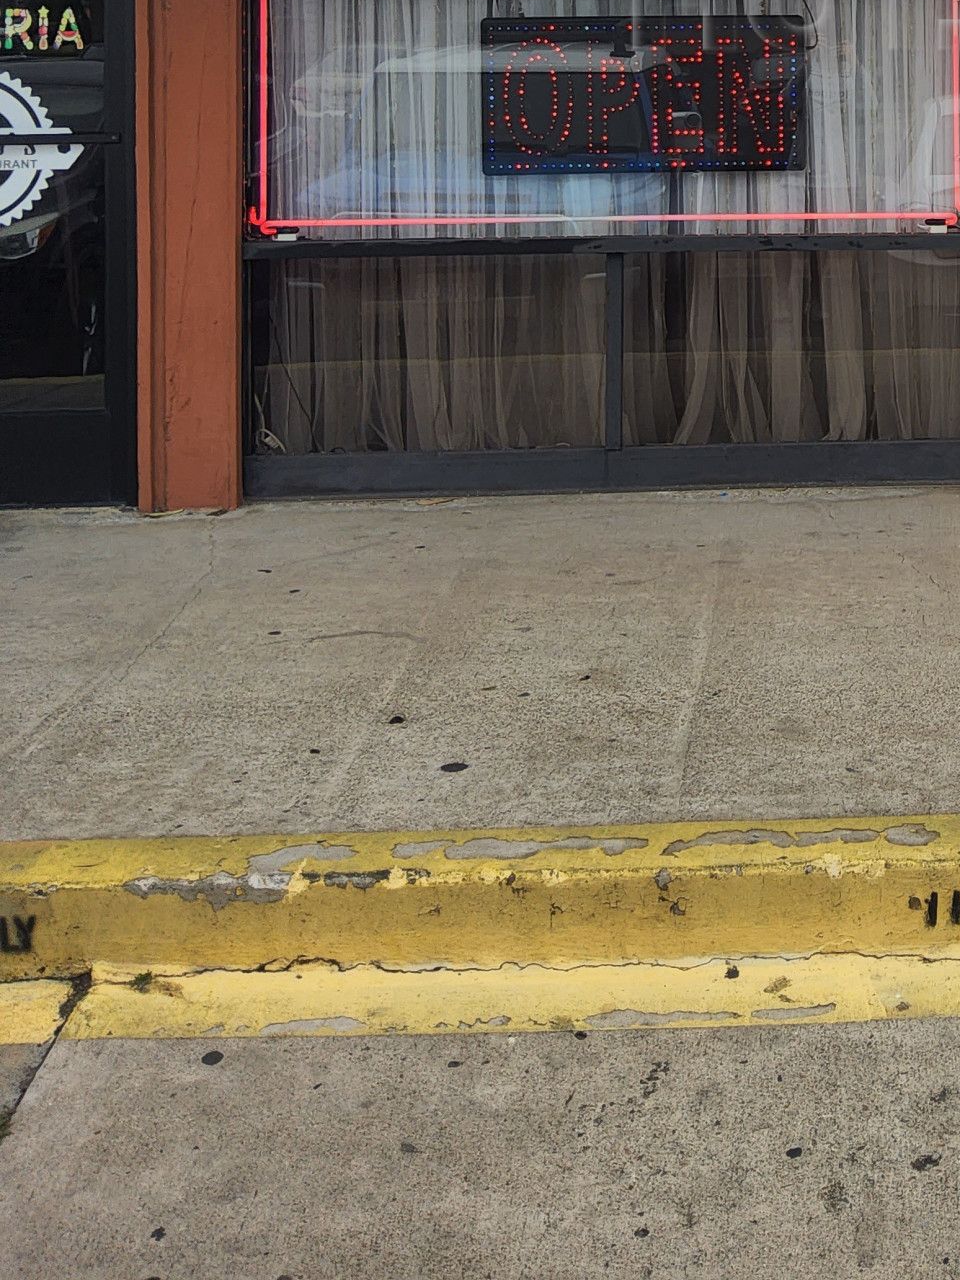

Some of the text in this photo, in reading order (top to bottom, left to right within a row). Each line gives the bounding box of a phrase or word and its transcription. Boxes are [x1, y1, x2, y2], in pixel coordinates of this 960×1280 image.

[0, 6, 84, 50] RIA
[504, 36, 784, 155] OPEN
[0, 159, 38, 169] RANT
